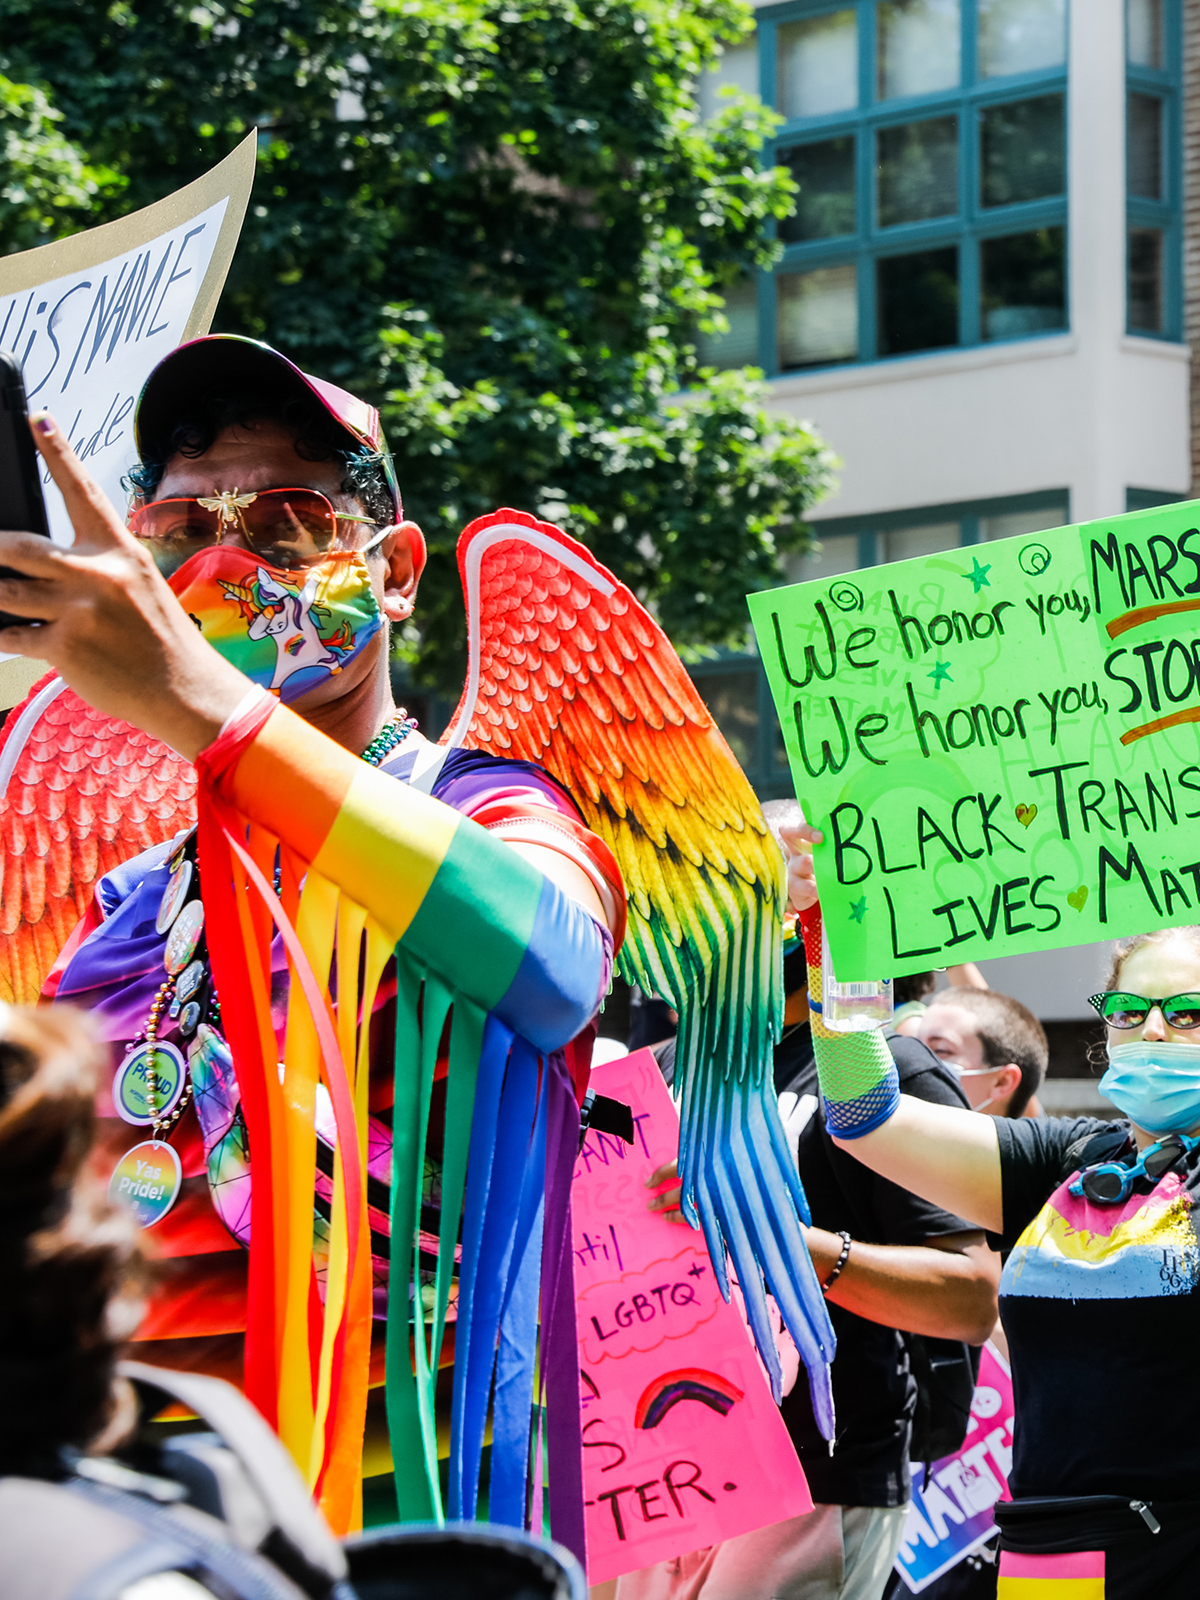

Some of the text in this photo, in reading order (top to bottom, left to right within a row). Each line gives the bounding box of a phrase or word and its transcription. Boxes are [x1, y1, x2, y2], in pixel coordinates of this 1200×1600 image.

[60, 222, 207, 394] NAME
[771, 599, 880, 689] We
[887, 589, 1014, 660] honor
[1026, 588, 1091, 635] you,
[793, 696, 890, 778] We
[905, 681, 1032, 758] honor
[1038, 681, 1109, 746] you,
[829, 792, 1026, 886] BLACK
[882, 874, 1062, 960] LIVES
[118, 1176, 166, 1201] Pride!
[135, 1159, 162, 1180] Yas
[572, 1113, 650, 1181] ANT
[590, 1262, 706, 1342] LGBTQ+
[584, 1459, 738, 1541] TER.
[895, 1427, 1013, 1566] MATTE
